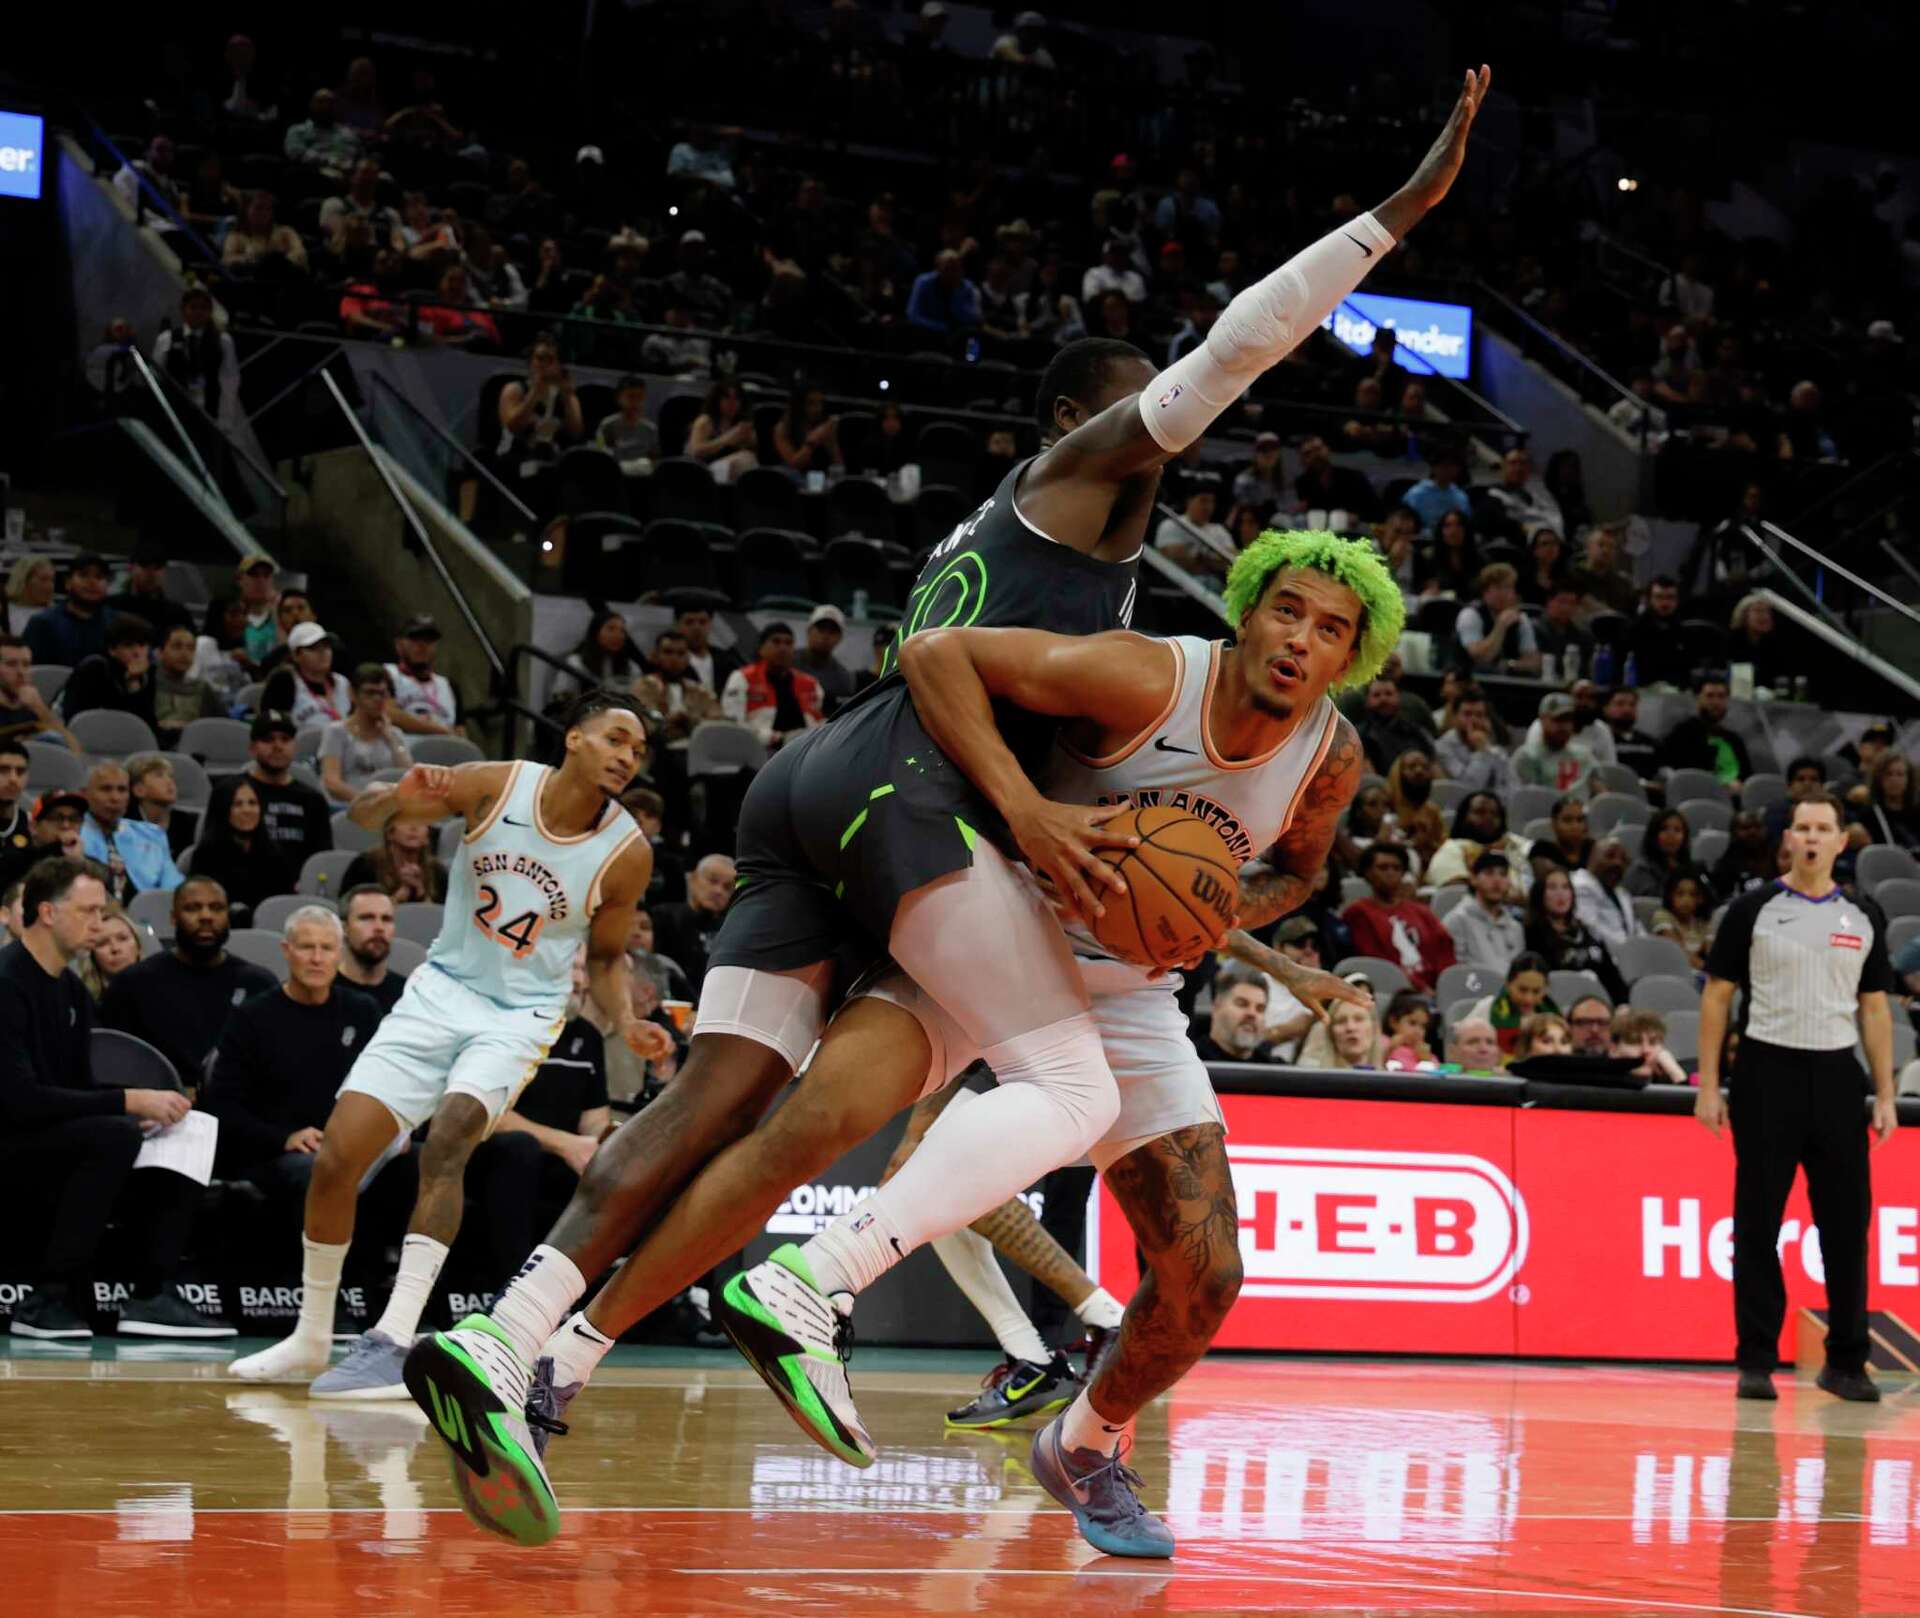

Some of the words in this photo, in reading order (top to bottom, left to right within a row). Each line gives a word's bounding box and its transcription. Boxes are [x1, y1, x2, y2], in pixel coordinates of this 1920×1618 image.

[472, 853, 508, 877] SAN
[512, 856, 568, 921] ANTONIO
[473, 884, 545, 960] 24
[1878, 1206, 1919, 1287] E
